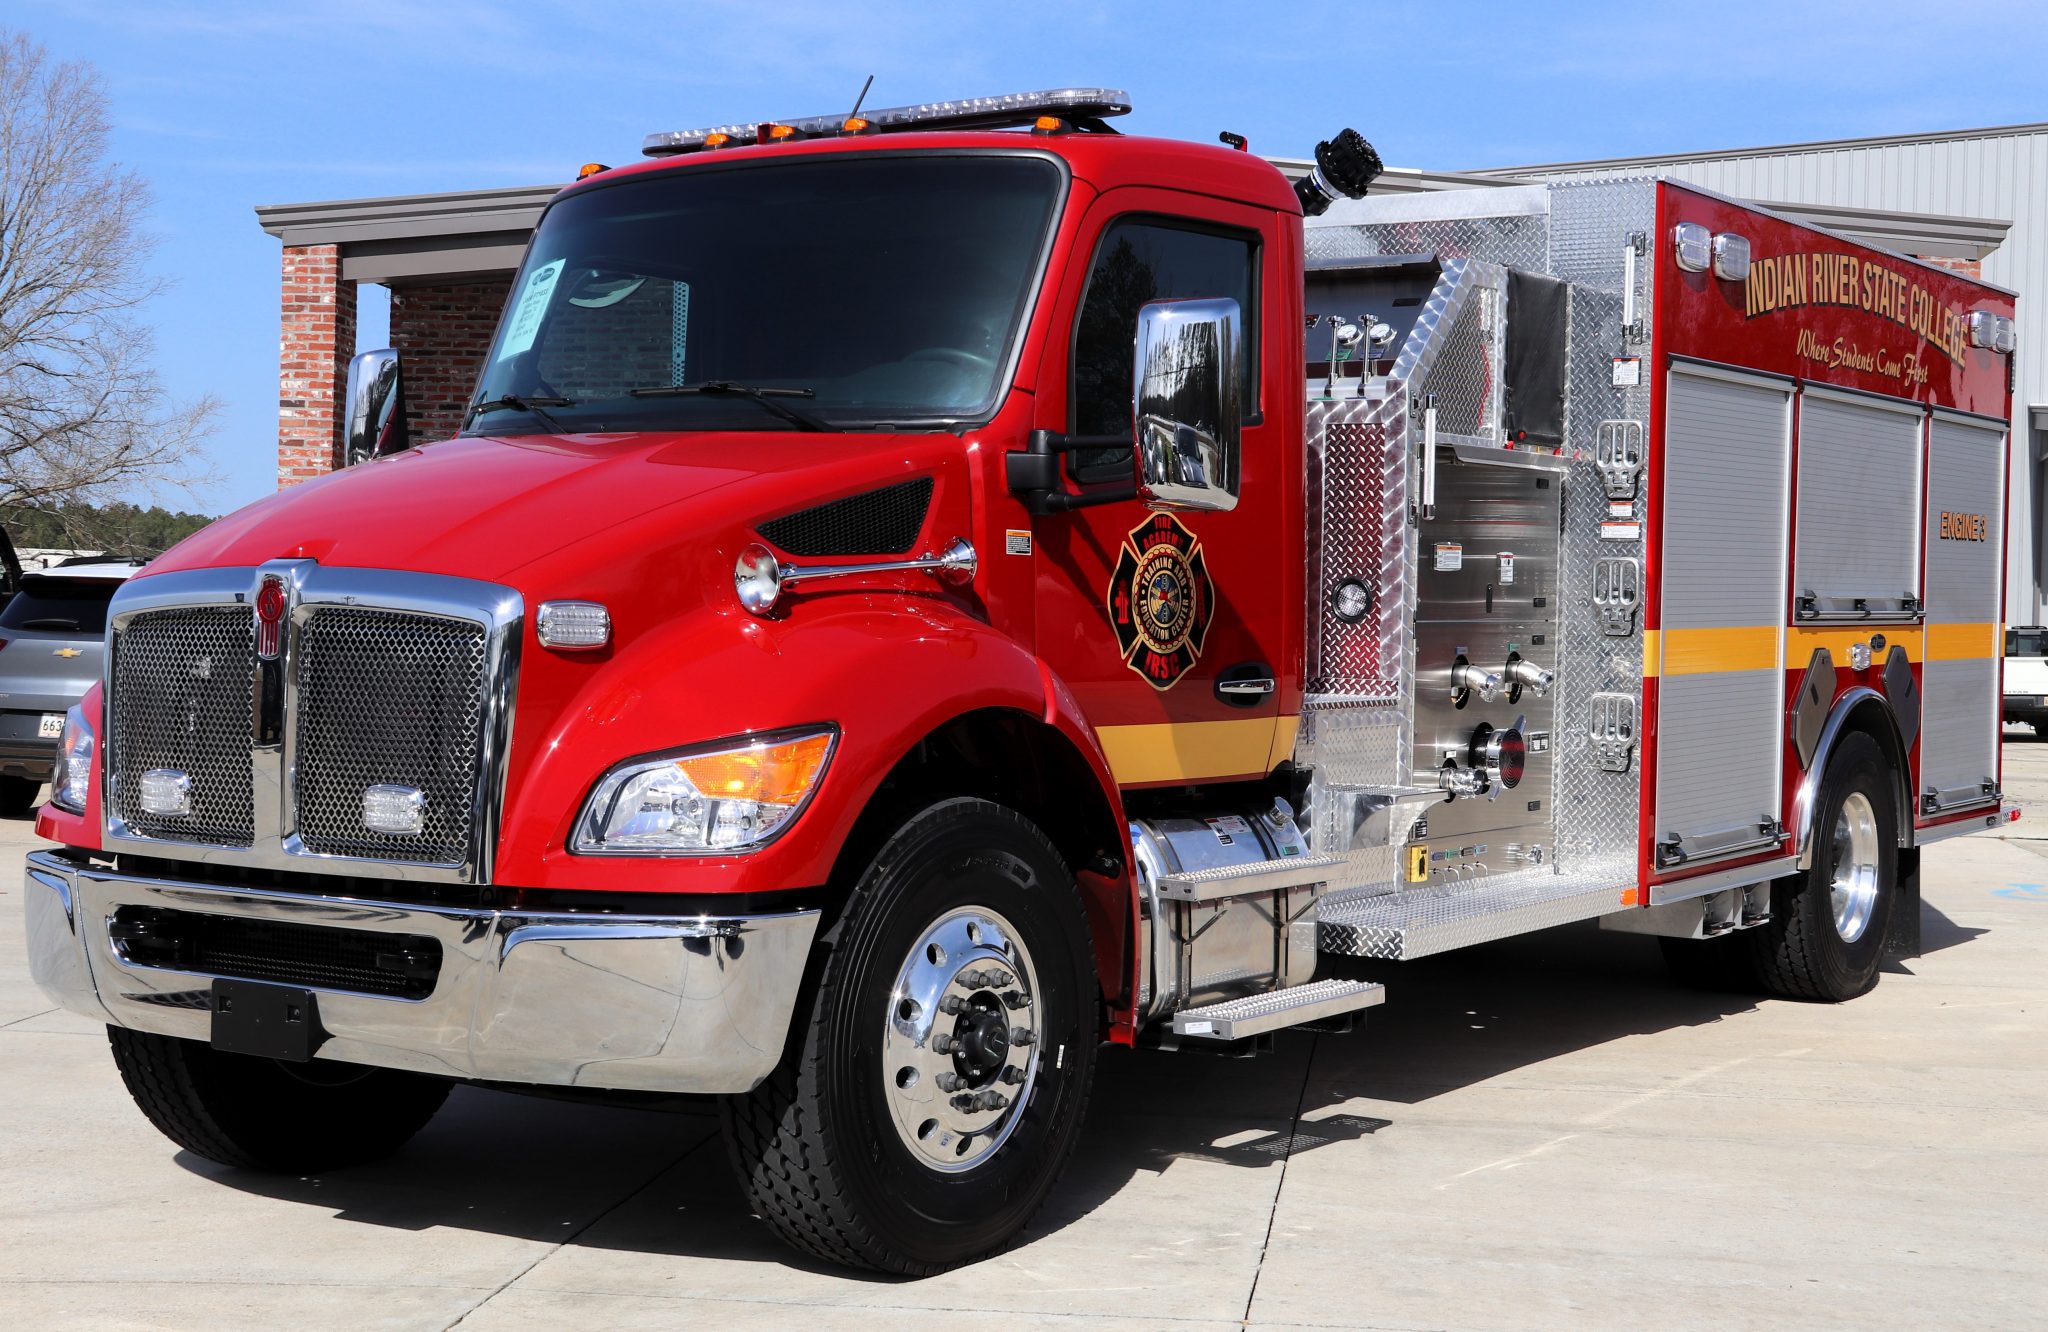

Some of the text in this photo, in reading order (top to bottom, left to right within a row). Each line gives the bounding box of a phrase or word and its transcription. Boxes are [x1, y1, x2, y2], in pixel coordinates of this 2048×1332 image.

[1745, 253, 1969, 369] INDIAN RIVER STATE COLLEGE
[1796, 327, 1929, 387] Where Students Come First
[1153, 516, 1173, 530] FIRE
[1940, 511, 1987, 542] ENGINE 3
[1143, 531, 1183, 550] ACADEMY
[1141, 556, 1187, 587] TRAINING AND
[1140, 599, 1189, 640] EDUCATION CENTER
[1143, 650, 1181, 680] IRSC
